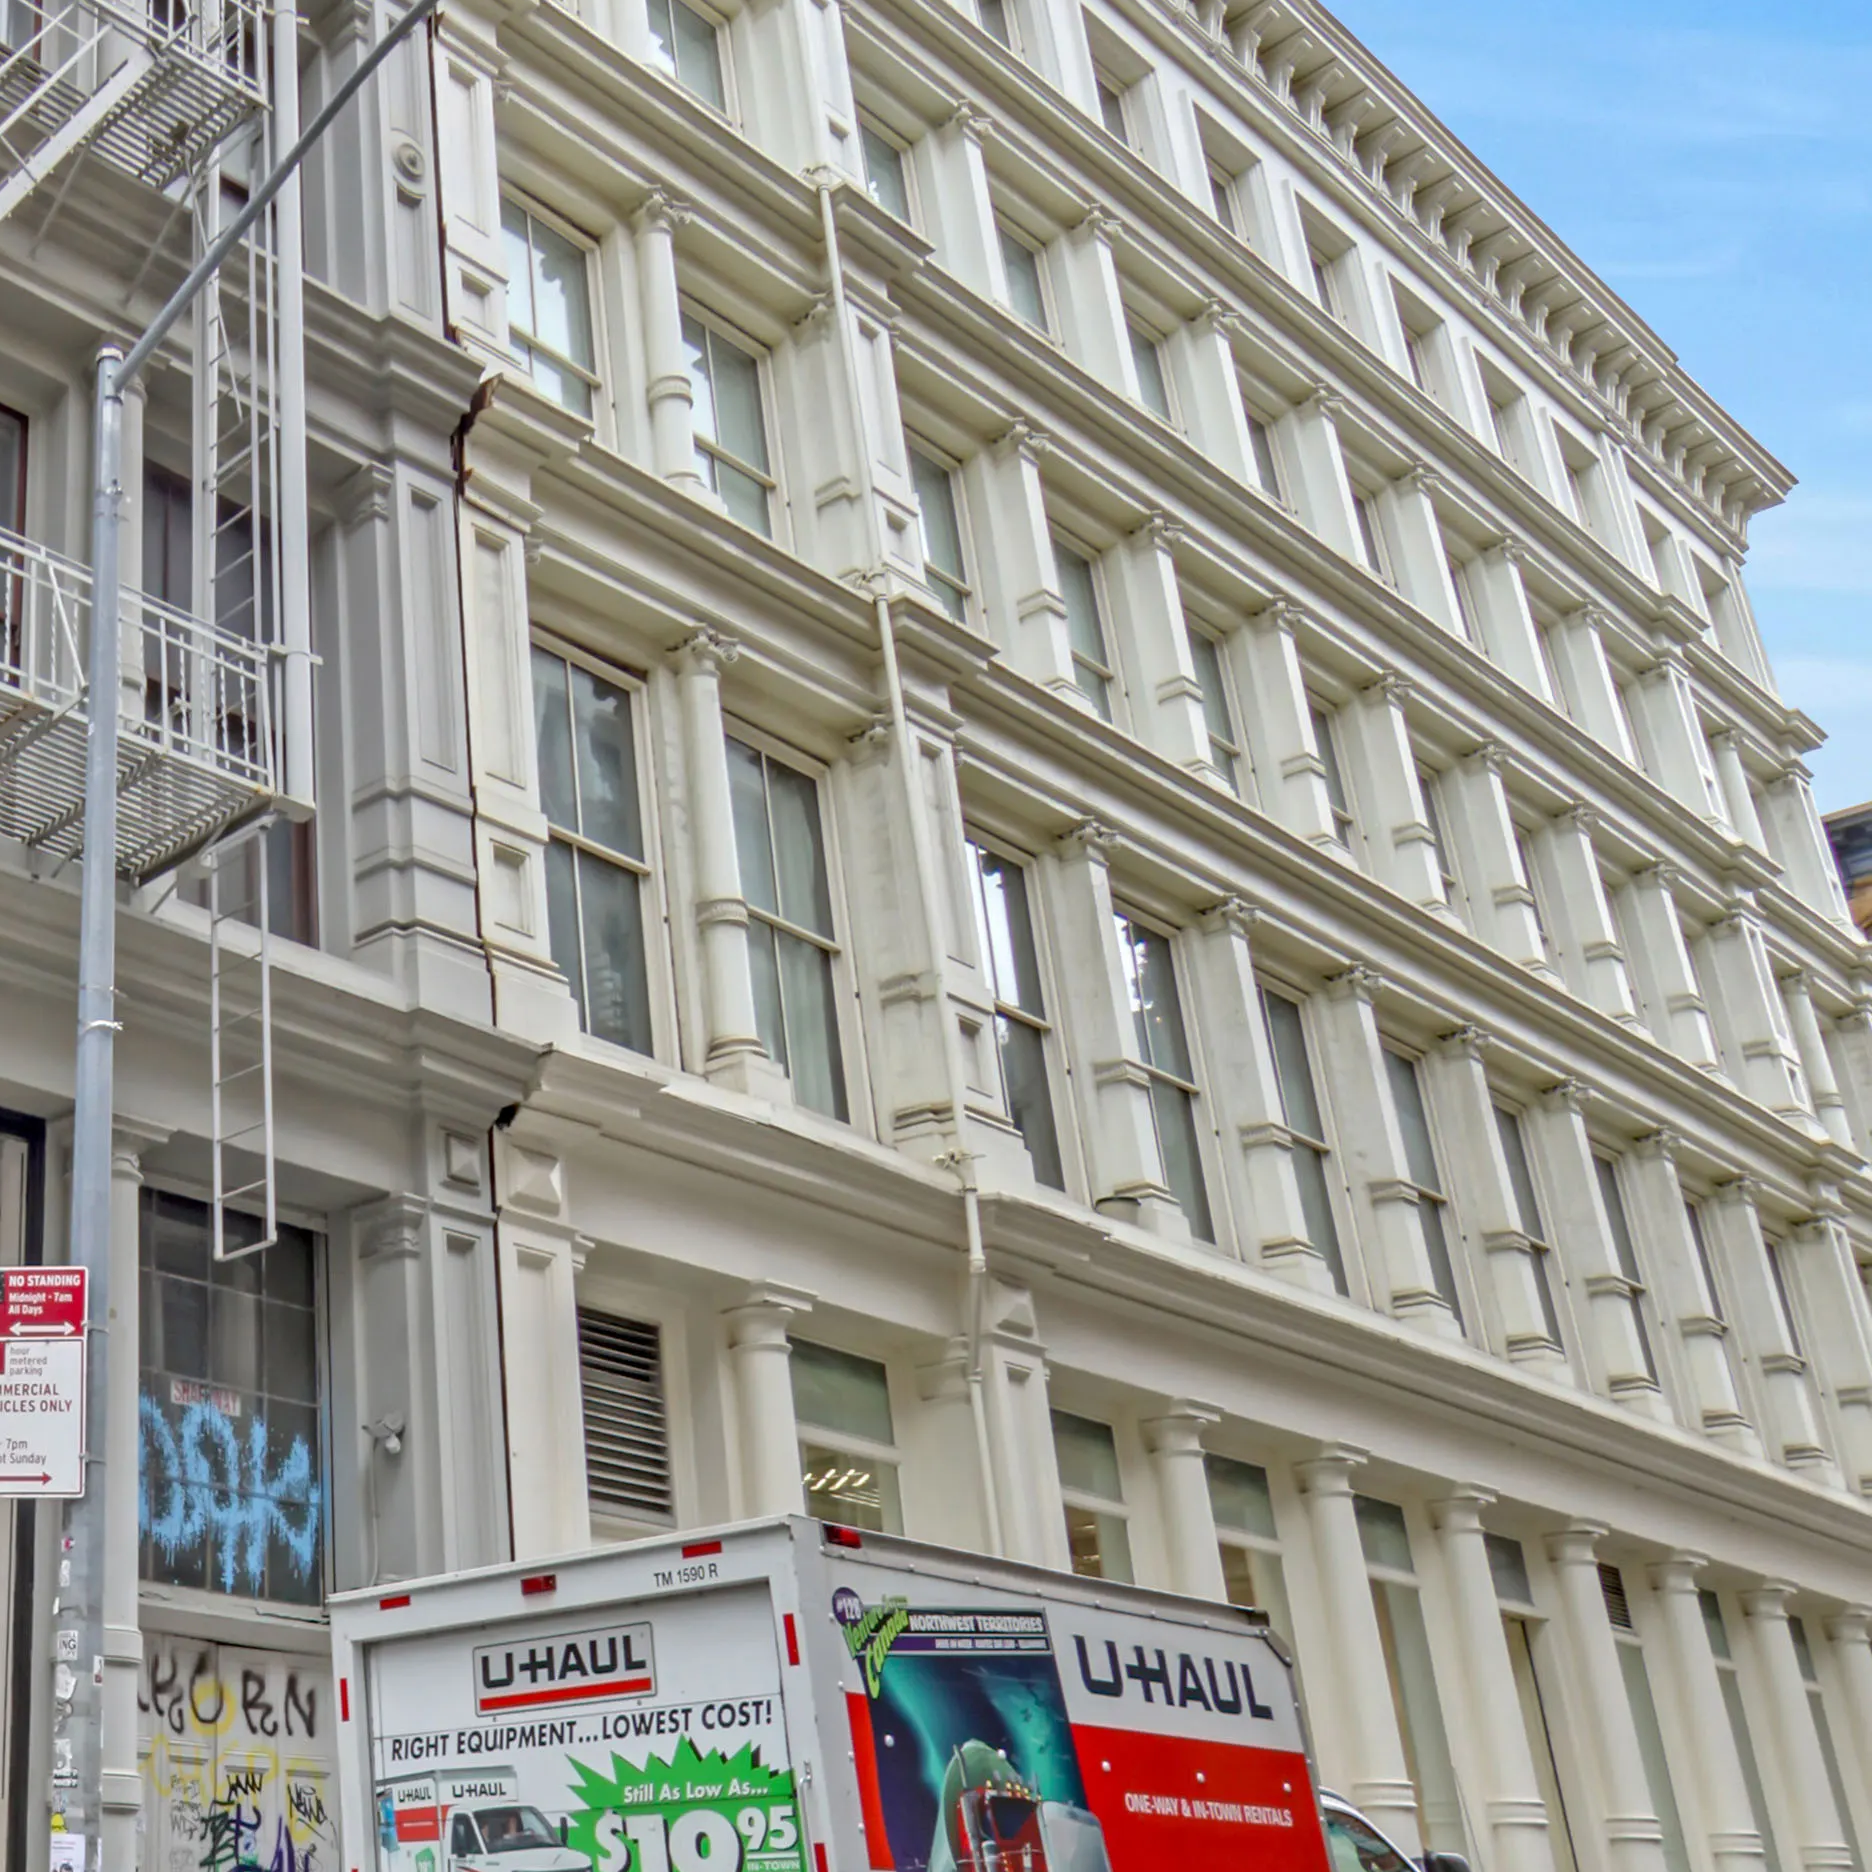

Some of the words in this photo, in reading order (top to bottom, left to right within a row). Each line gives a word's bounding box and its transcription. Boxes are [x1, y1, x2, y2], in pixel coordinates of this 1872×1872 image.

[8, 1275, 25, 1287] NO
[27, 1274, 81, 1287] STANDING
[8, 1292, 46, 1304] Midnight
[53, 1292, 73, 1302] 7am
[8, 1304, 20, 1315] All
[21, 1304, 43, 1317] Days
[10, 1346, 30, 1355] hour
[9, 1356, 48, 1365] metered
[9, 1367, 43, 1377] parking
[39, 1399, 73, 1413] ONLY
[173, 1381, 240, 1416] SHAFWAY
[6, 1438, 28, 1451] 7pm
[9, 1453, 47, 1467] Sunday
[653, 1571, 673, 1588] TM
[677, 1565, 706, 1584] 1590
[708, 1562, 719, 1578] R
[909, 1614, 976, 1632] NORTHWEST
[977, 1616, 1045, 1633] TERRITORIES
[481, 1634, 647, 1690] U-HAUL
[1073, 1633, 1274, 1721] U-HAUL
[391, 1733, 450, 1762] RIGHT
[701, 1699, 773, 1729] COST!
[398, 1787, 432, 1804] U-HAUL
[451, 1781, 507, 1799] U-HAUL
[623, 1784, 654, 1804] Still
[659, 1785, 681, 1801] As
[686, 1781, 723, 1799] Low
[728, 1778, 769, 1797] As...
[1124, 1792, 1178, 1816] ONE-WAY
[1181, 1797, 1192, 1818] &
[1192, 1800, 1243, 1823] IN-TOWN
[1245, 1804, 1293, 1827] RENTALS
[747, 1859, 801, 1872] IN-TOWN
